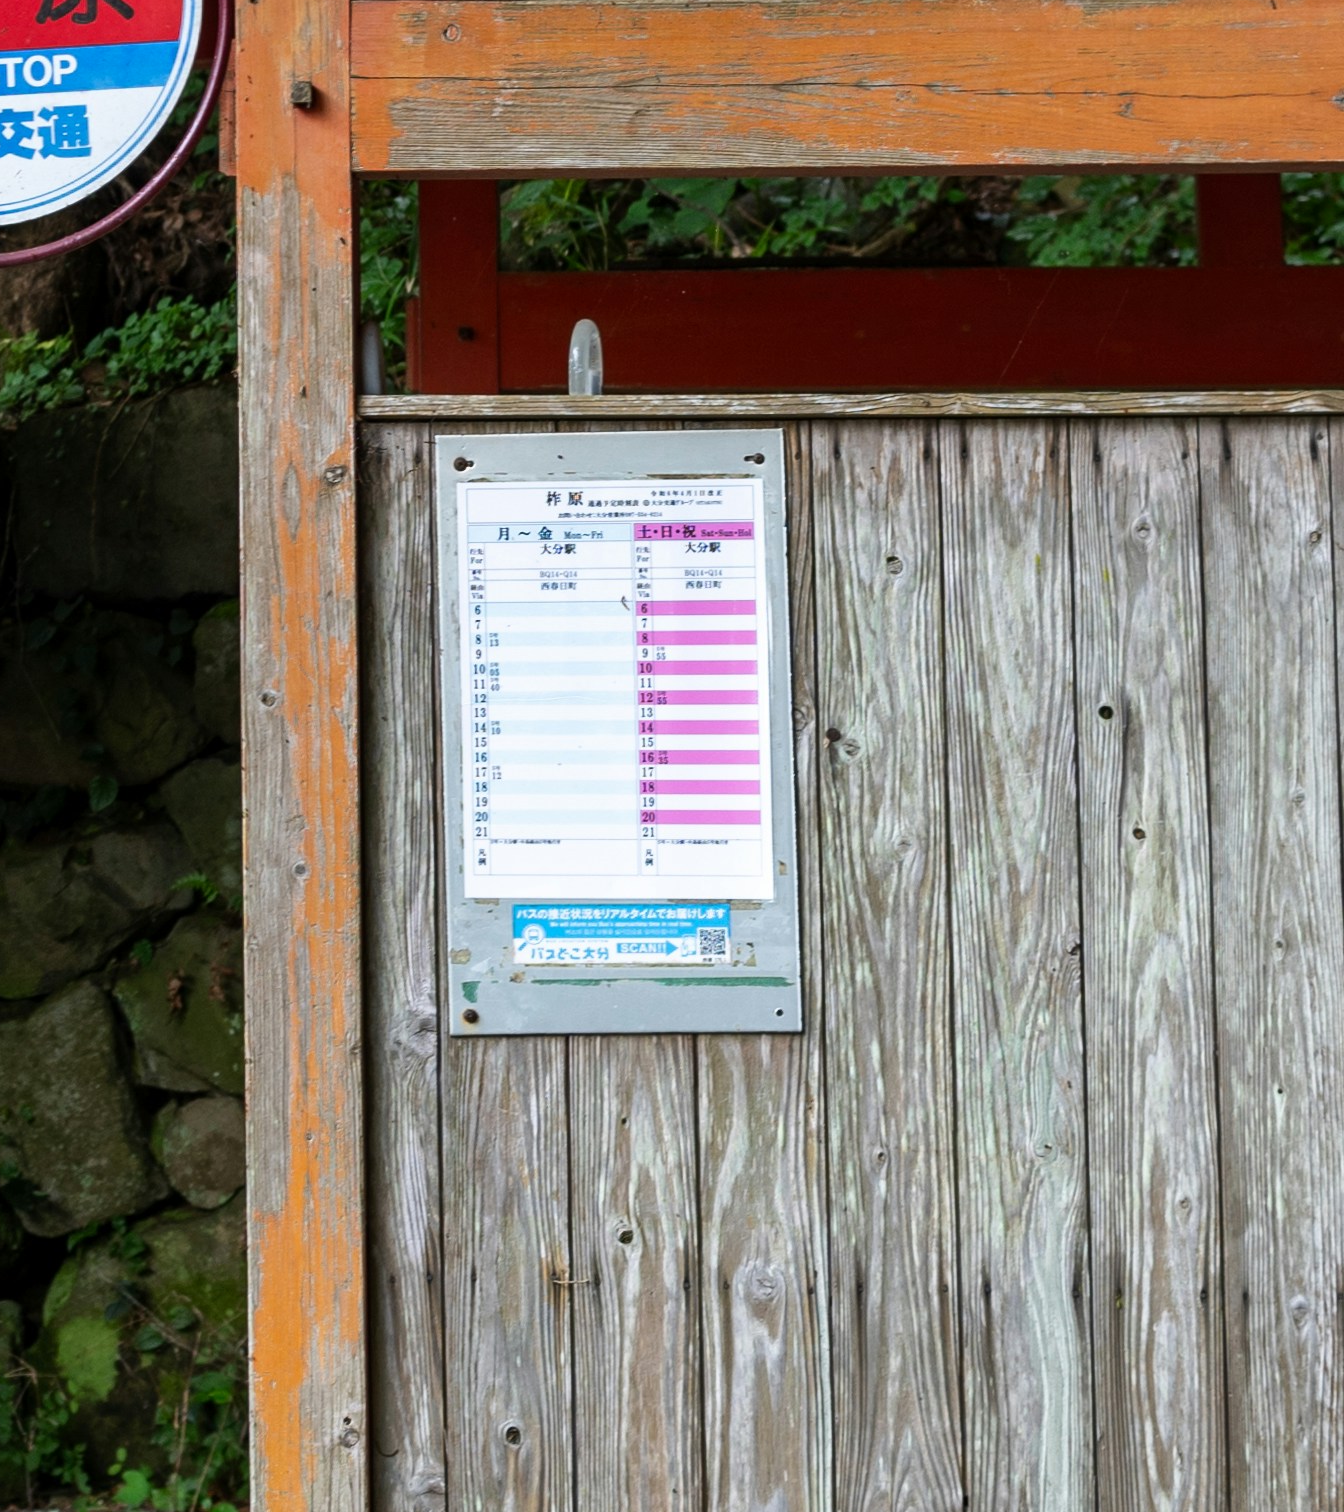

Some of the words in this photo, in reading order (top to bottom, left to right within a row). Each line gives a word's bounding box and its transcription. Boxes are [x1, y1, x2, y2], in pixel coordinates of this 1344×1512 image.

[540, 543, 576, 555] 大分駅
[685, 542, 721, 553] 大分駅
[474, 605, 481, 615] 6
[641, 604, 648, 614] 6
[475, 620, 481, 630] 7
[642, 618, 648, 628] 7
[475, 635, 482, 644] 8
[642, 633, 648, 643] 8
[476, 649, 482, 659] 9
[642, 648, 648, 658] 9
[474, 664, 486, 674] 10
[640, 663, 652, 673] 10
[474, 679, 486, 689] 11
[640, 678, 652, 688] 11
[474, 694, 486, 703] 12
[640, 693, 653, 702] 12
[474, 708, 486, 718] 13
[641, 708, 653, 717] 13
[474, 723, 486, 732] 14
[641, 723, 653, 732] 14
[475, 738, 486, 747] 15
[642, 738, 654, 747] 15
[475, 752, 487, 762] 16
[642, 752, 654, 762] 16
[475, 767, 487, 777] 17
[642, 767, 654, 777] 17
[476, 782, 488, 792] 18
[642, 782, 654, 792] 18
[476, 797, 488, 807] 19
[642, 797, 654, 807] 19
[476, 812, 488, 822] 20
[642, 812, 655, 822] 20
[476, 827, 488, 836] 21
[642, 827, 654, 837] 21
[516, 907, 725, 920] バスの接近状況をリアルタイムでお届けします
